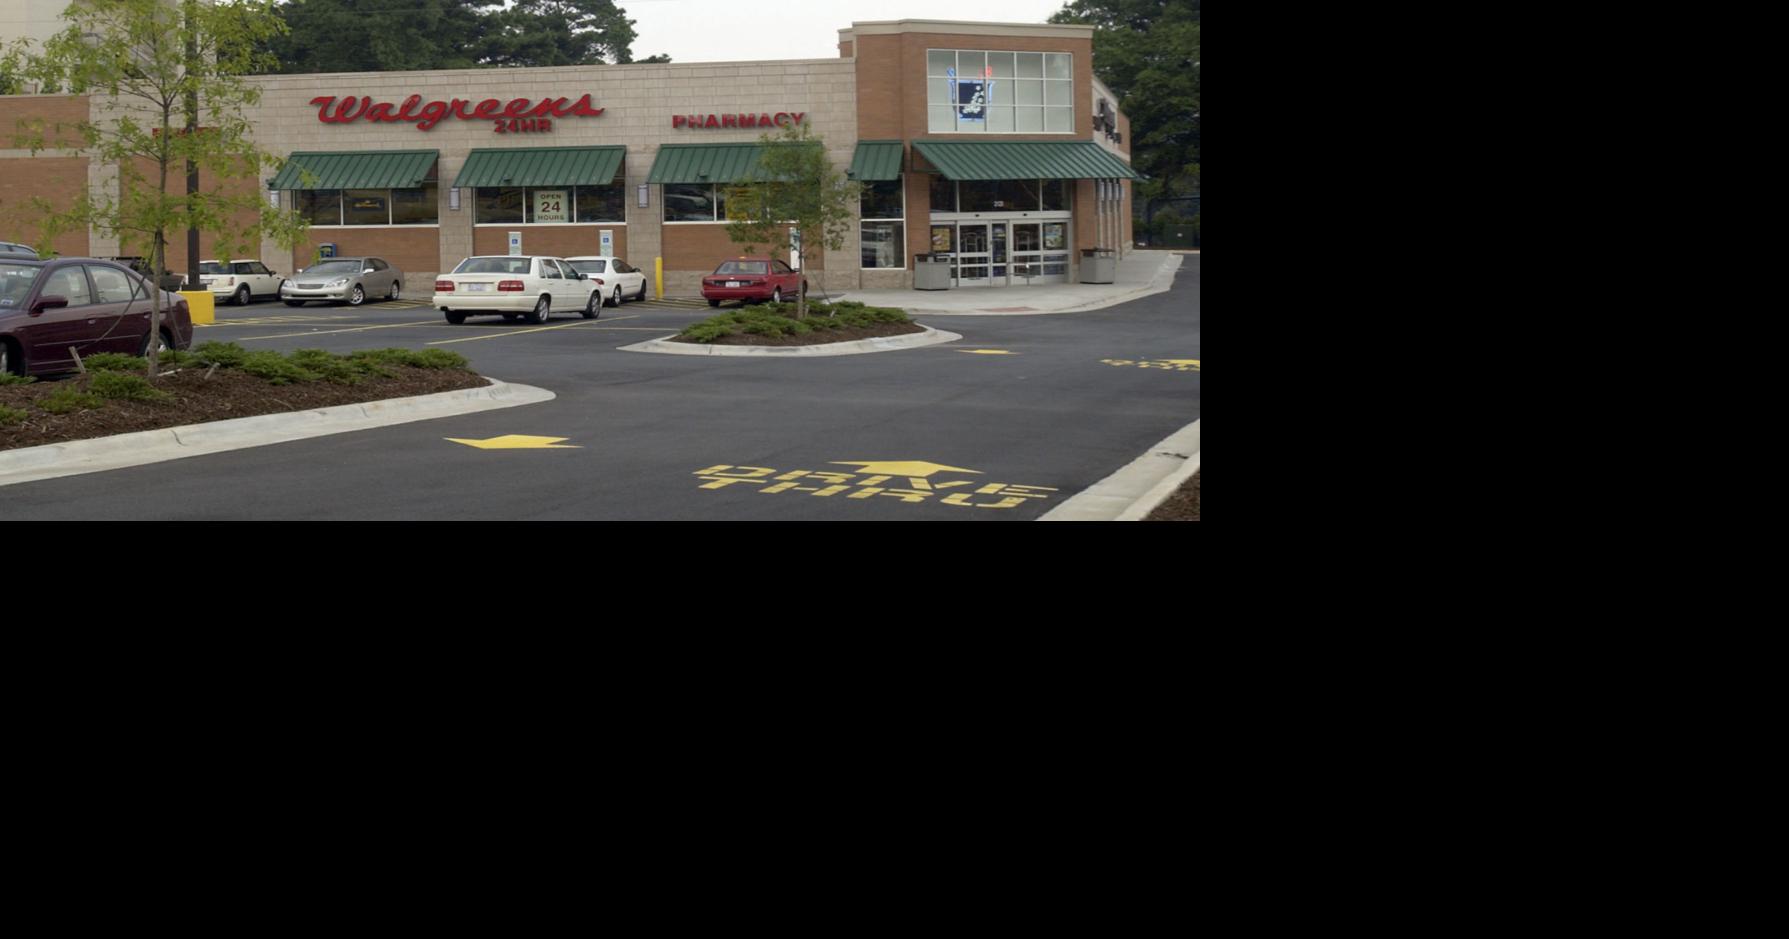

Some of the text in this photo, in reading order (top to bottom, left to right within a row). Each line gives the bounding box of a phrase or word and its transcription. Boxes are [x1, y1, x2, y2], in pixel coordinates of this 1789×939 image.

[310, 94, 605, 132] Walgreens
[672, 112, 805, 129] PHARMACY
[494, 119, 552, 133] 24HR
[541, 201, 561, 213] 24
[692, 464, 1059, 498] DRIVE
[697, 476, 1027, 508] THRU
